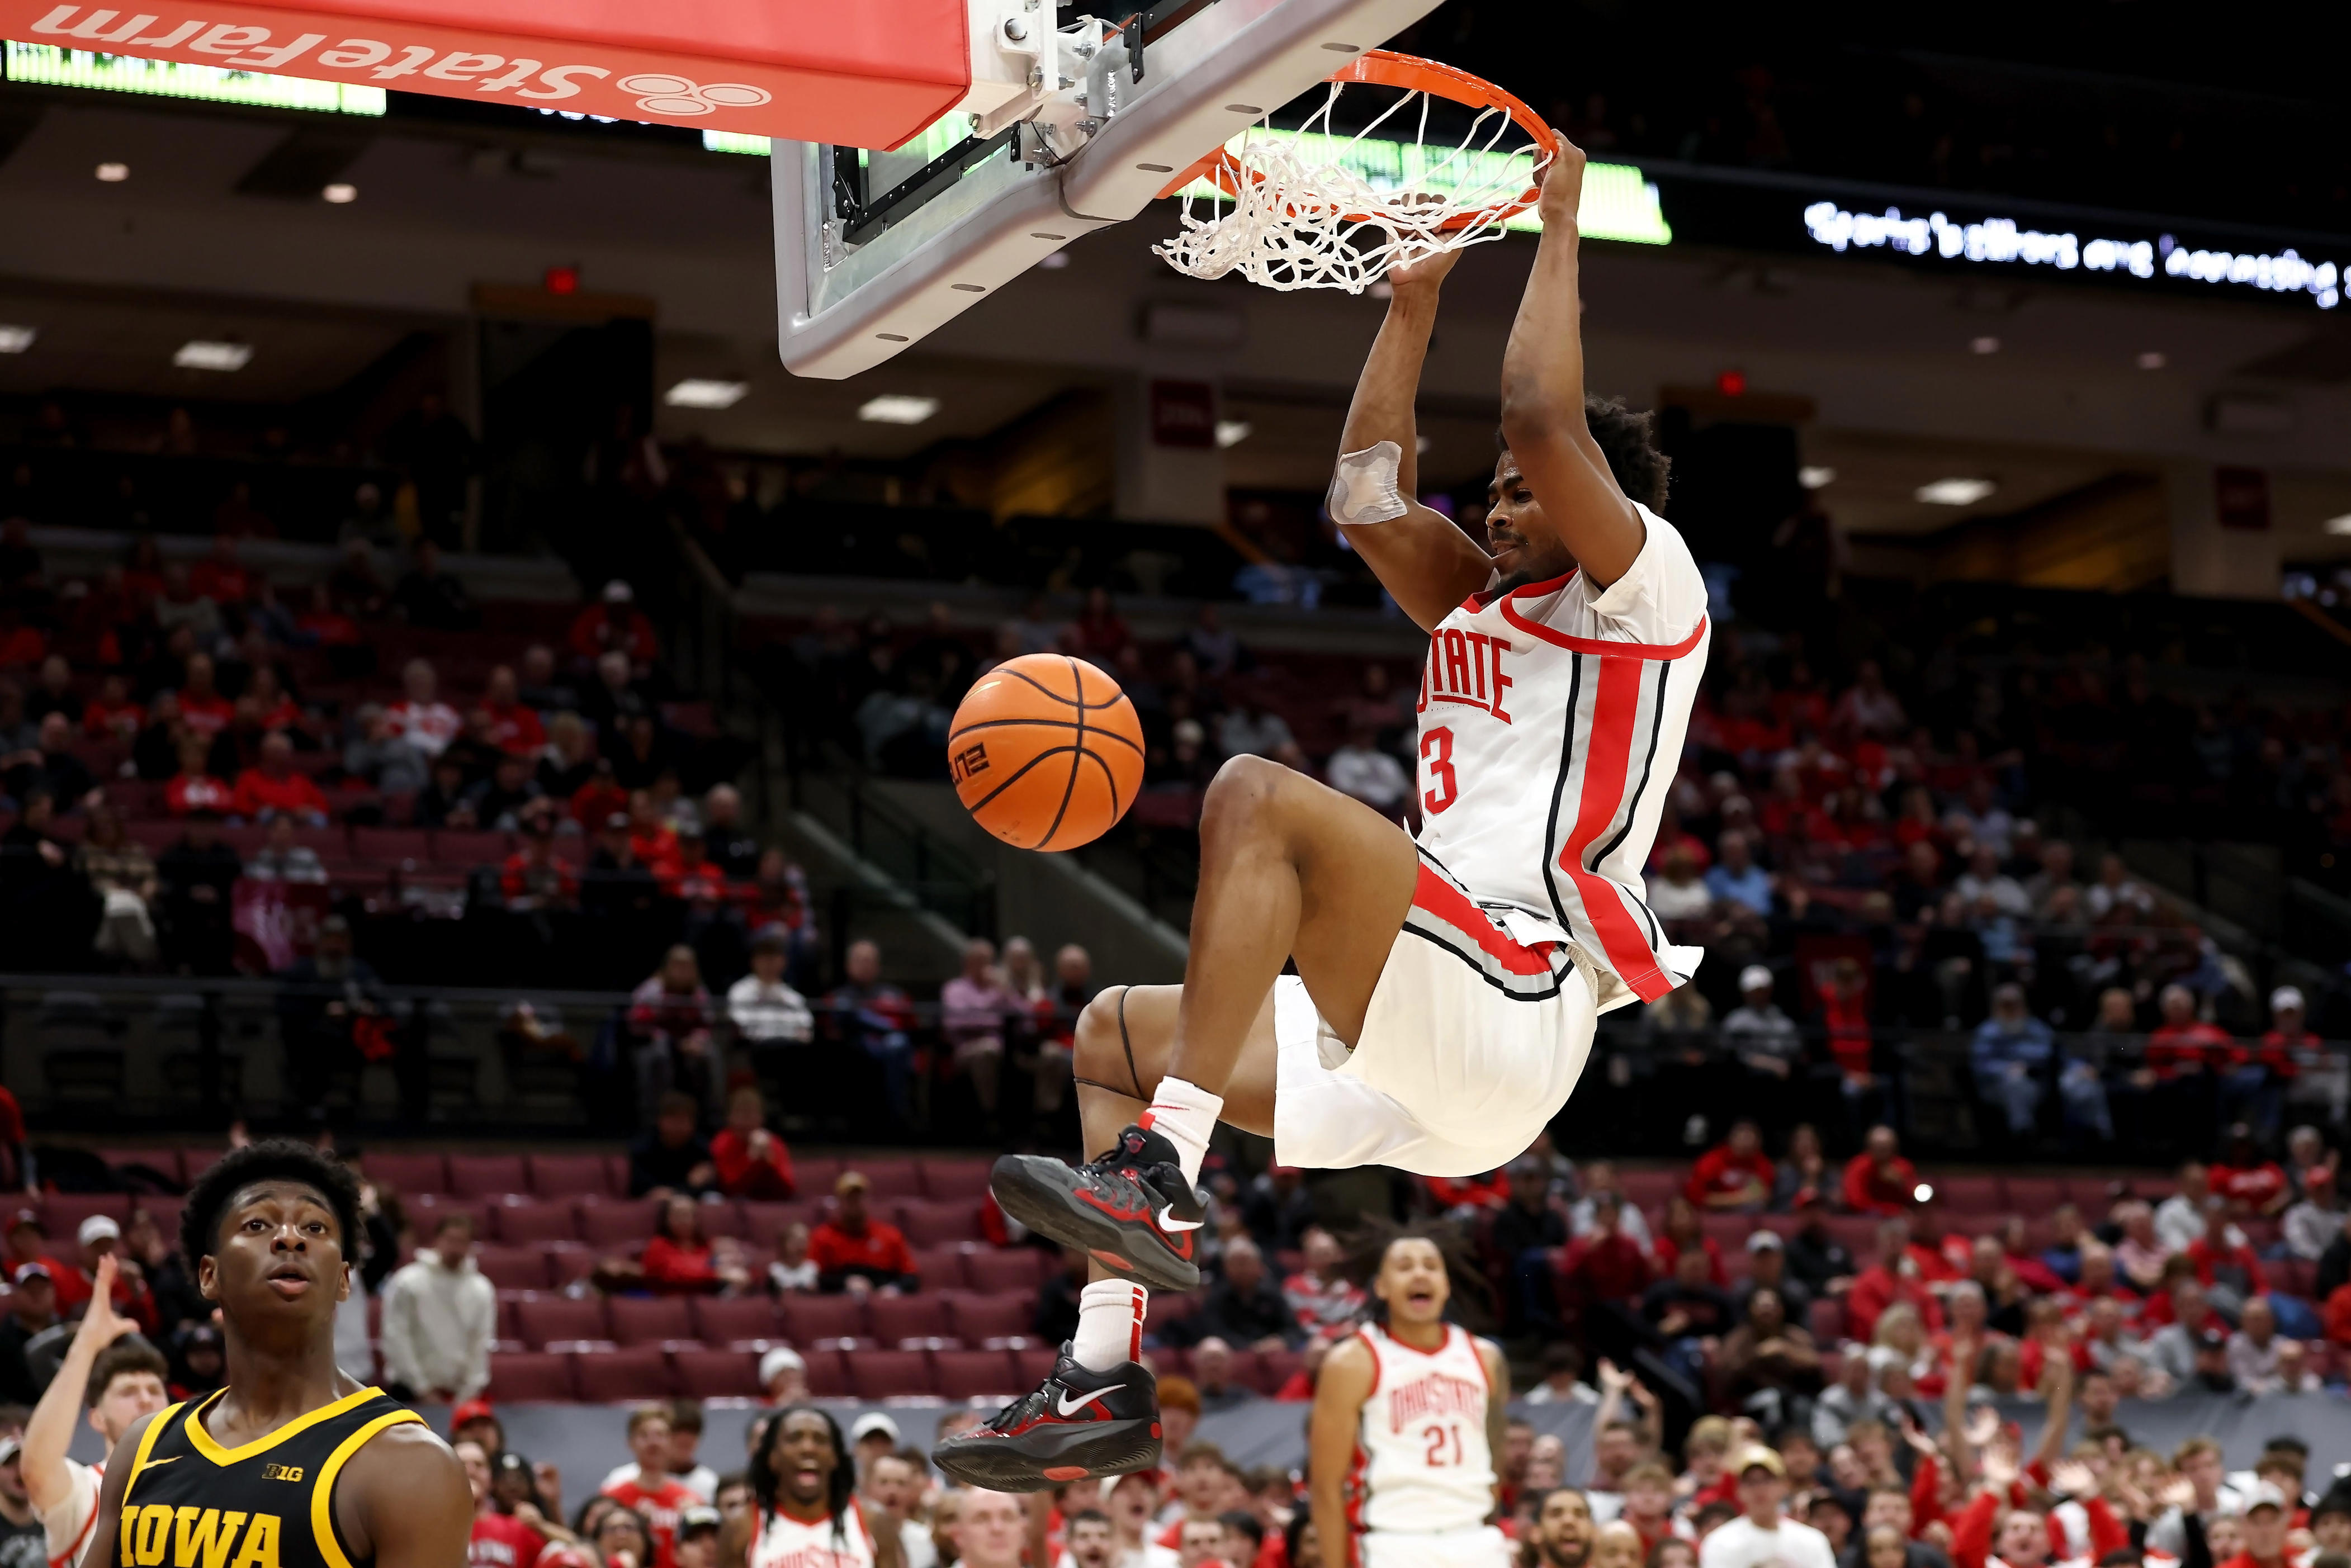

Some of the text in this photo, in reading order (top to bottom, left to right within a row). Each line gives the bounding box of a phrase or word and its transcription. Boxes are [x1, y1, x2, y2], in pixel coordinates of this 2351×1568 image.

[1416, 628, 1513, 726] TATE
[1423, 1425, 1463, 1467] 21
[120, 1504, 281, 1568] IOWA
